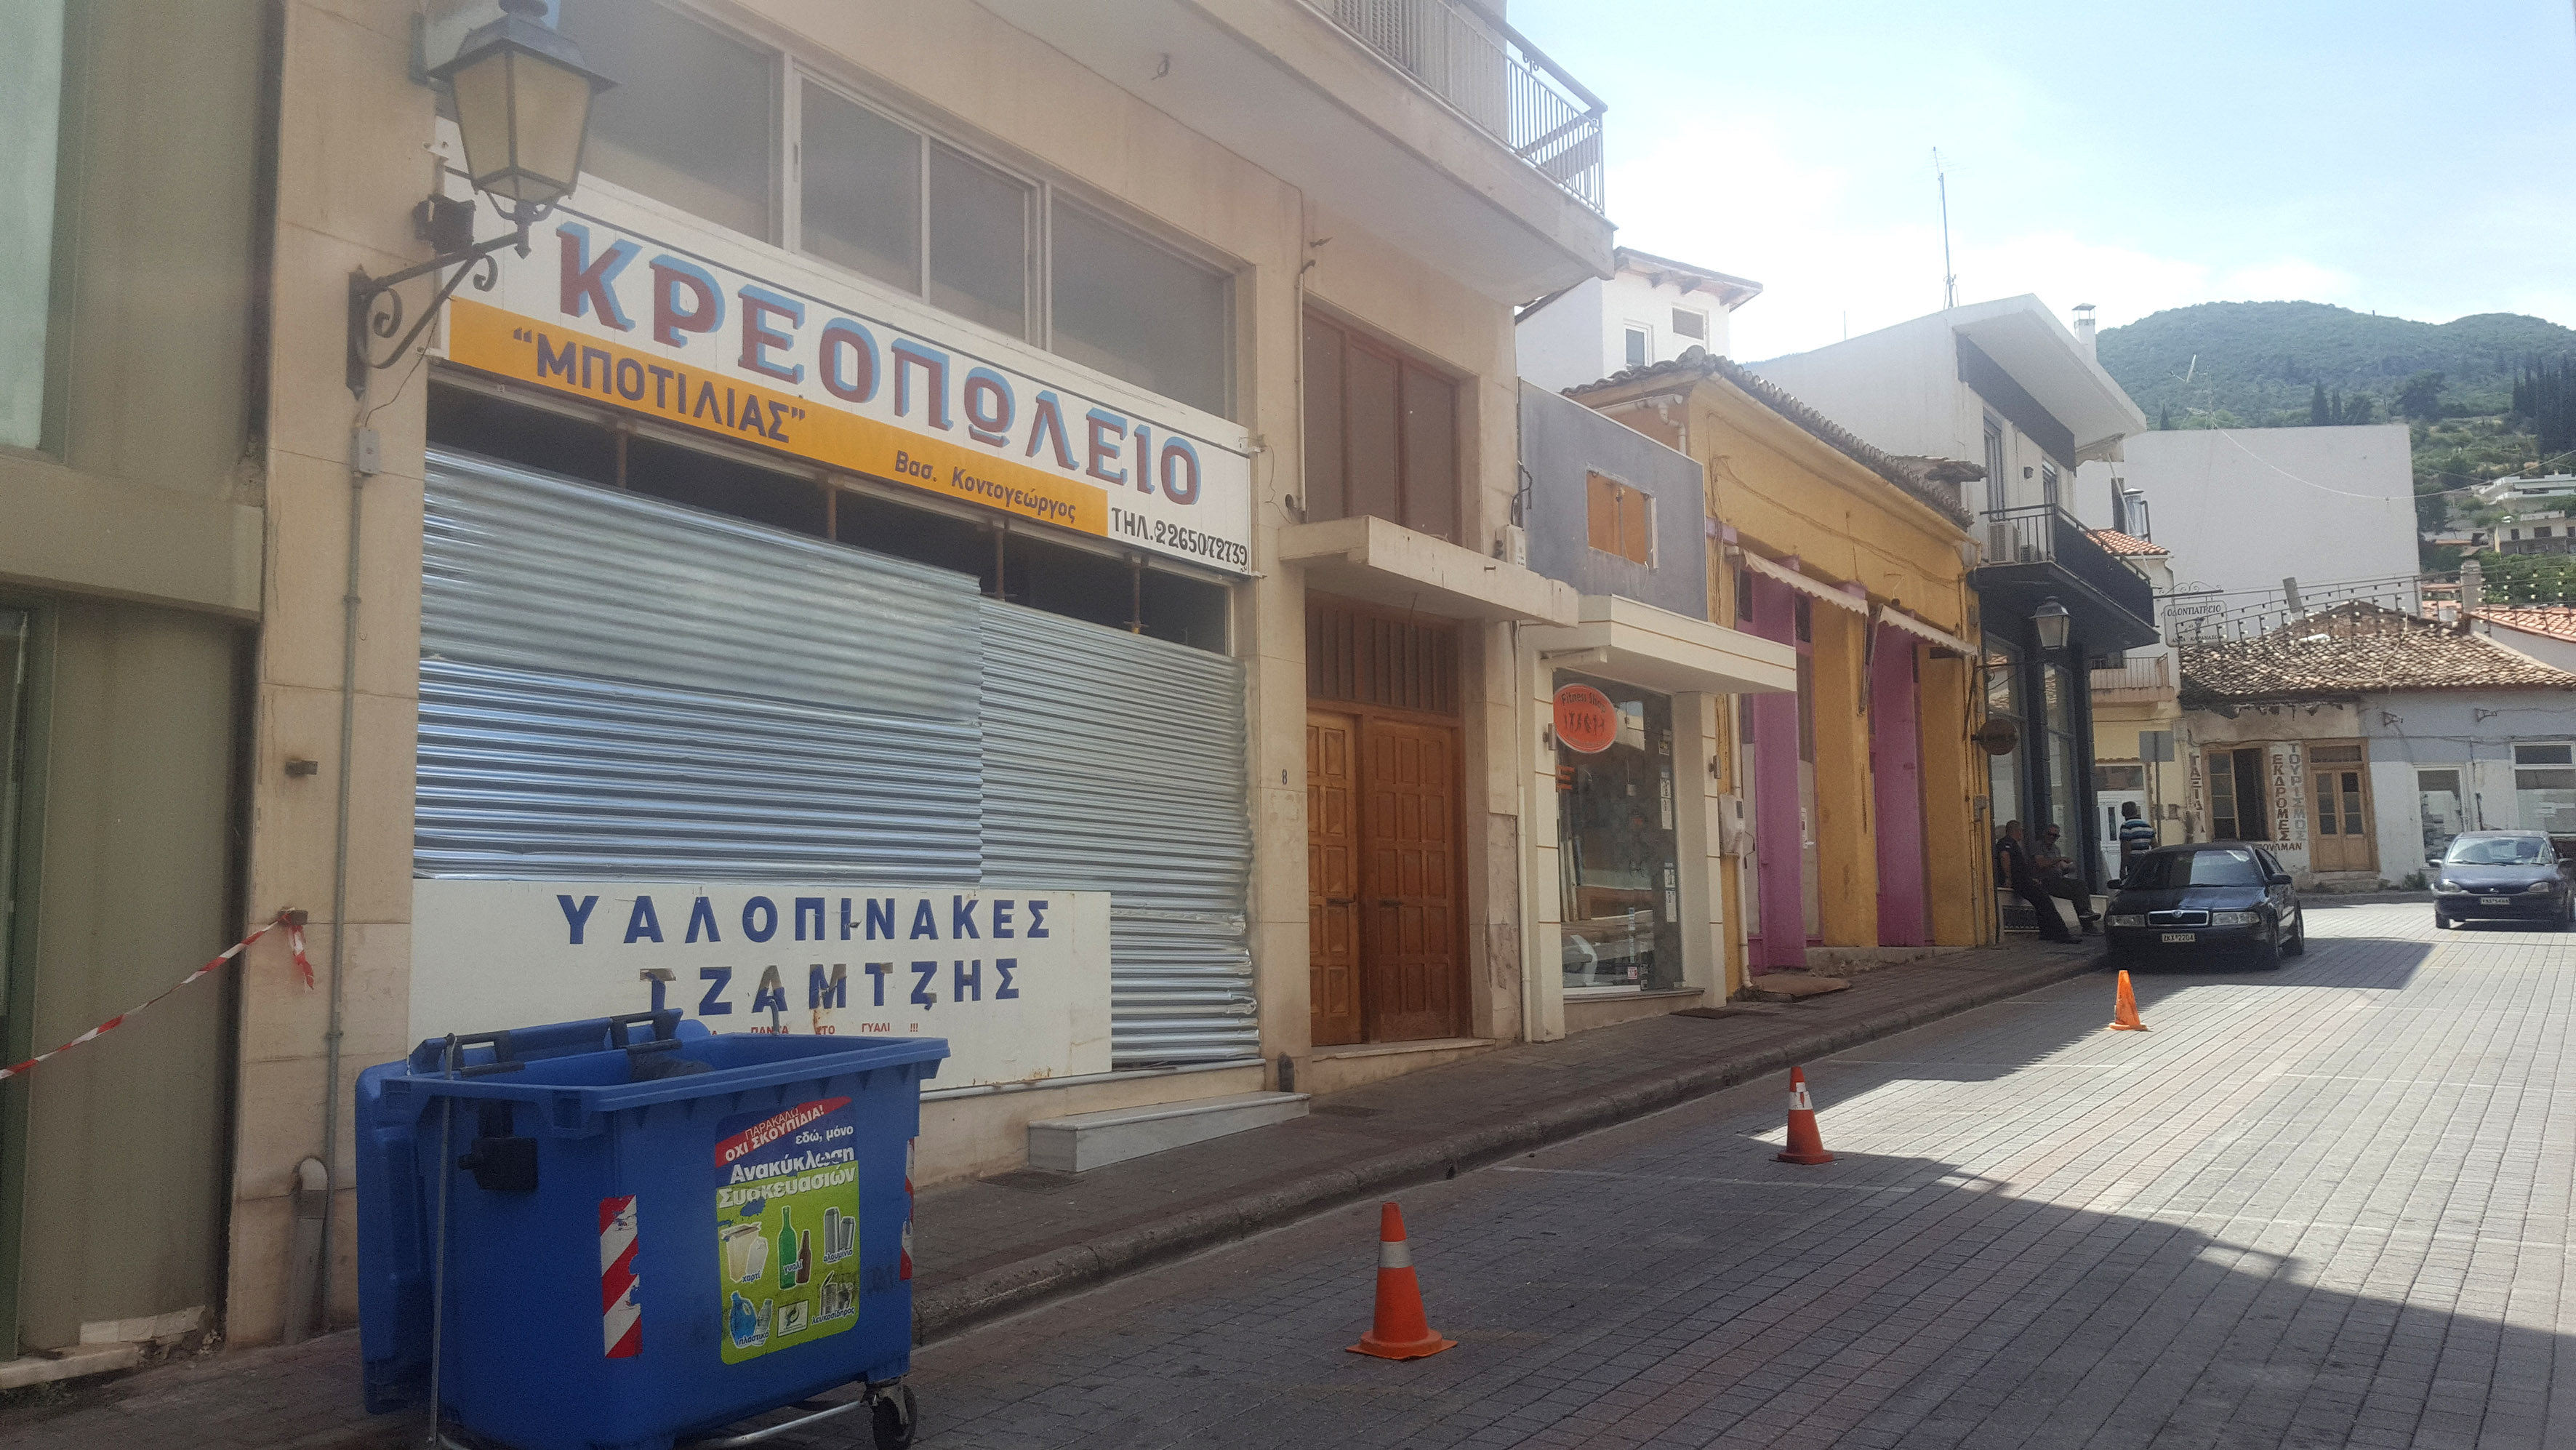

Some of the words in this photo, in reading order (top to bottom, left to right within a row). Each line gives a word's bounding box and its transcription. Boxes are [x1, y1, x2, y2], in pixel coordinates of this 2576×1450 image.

[556, 221, 1201, 505] ΚΡΕΟΠΩΛΕΙΟ
[895, 450, 937, 481] Βασ.
[952, 466, 1076, 524] Κοντογεώργος
[1561, 692, 1587, 705] Fitness
[1281, 769, 1288, 785] 8
[2273, 754, 2290, 841] ΕΚΔΡΟΜΕΣ
[556, 894, 1050, 945] ΥΑΛΟΠΙΝΑΚΕΣ
[640, 958, 1019, 1016] ΤΖΑΜΤΖΗΣ
[750, 1025, 789, 1035] ΠΑΝΑ
[862, 1022, 891, 1033] ΓΥΑΛΙ
[725, 1142, 749, 1162] ΟΧΙ
[751, 1105, 824, 1149] ΣΚΟΥΠΙΔΙΑ!
[795, 1129, 823, 1145] εδώ,
[826, 1125, 854, 1142] μόνο
[730, 1146, 854, 1185] Ανακύκλωση
[718, 1164, 856, 1209] Συσκευασιών
[823, 1248, 854, 1263] αλουμίνιο
[742, 1271, 761, 1283] χαρτί
[783, 1259, 803, 1275] γυαλί
[811, 1307, 855, 1325] λευκοσίδηρος
[738, 1331, 769, 1346] πλαστικό
